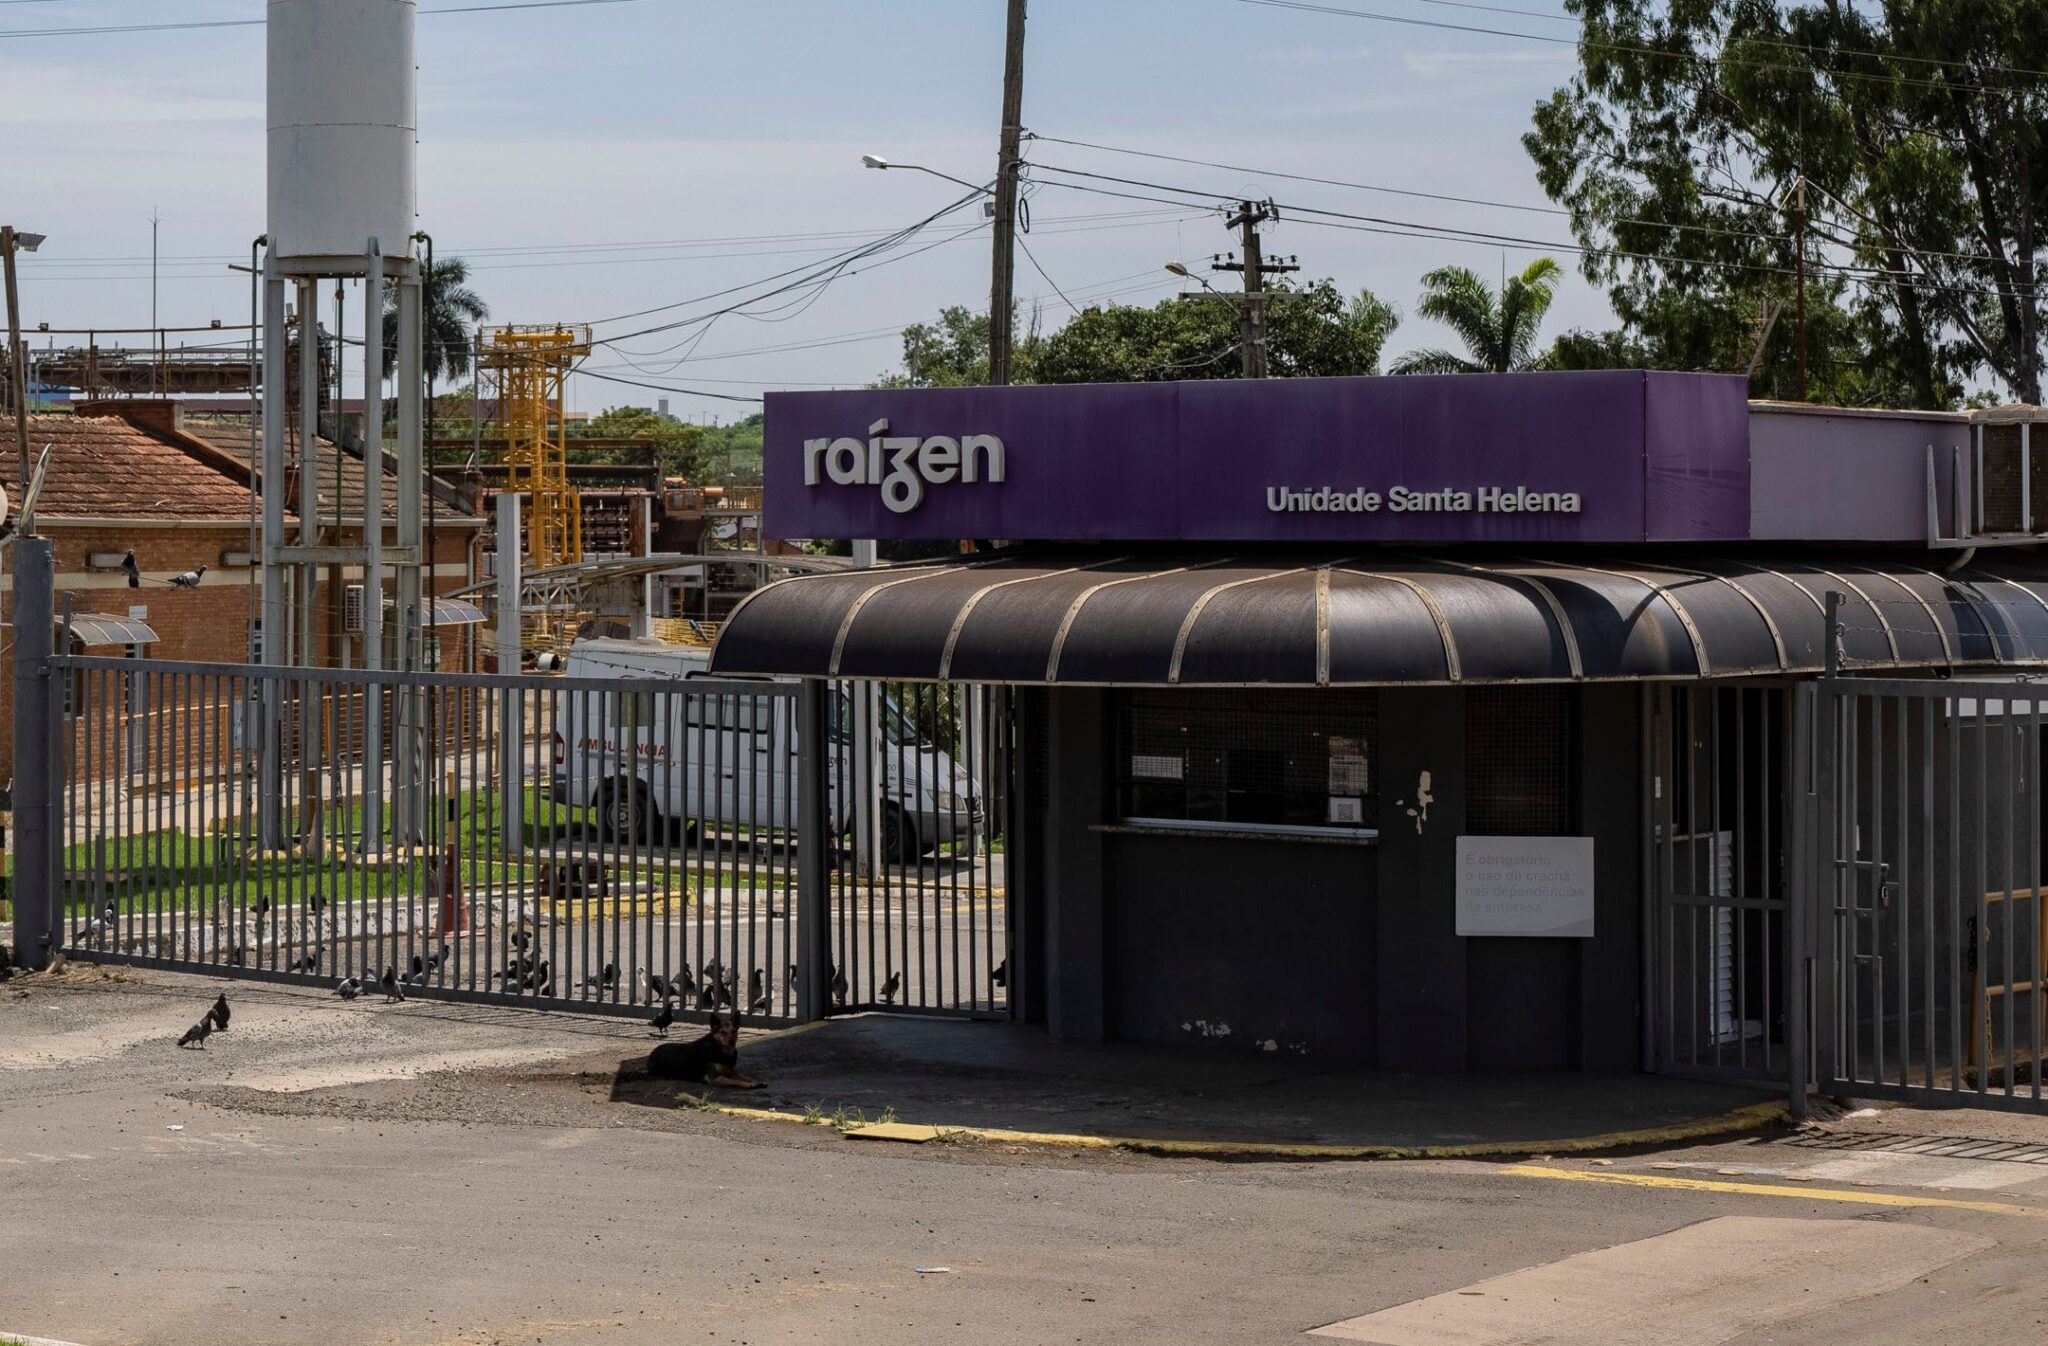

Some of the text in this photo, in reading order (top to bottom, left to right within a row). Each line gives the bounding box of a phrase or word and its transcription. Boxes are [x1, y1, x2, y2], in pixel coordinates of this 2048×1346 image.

[803, 418, 1006, 514] raízen
[1266, 486, 1582, 513] Unidade Santa Helena
[1465, 872, 1473, 881] o
[1478, 872, 1502, 881] uso
[1506, 870, 1522, 881] de
[1465, 887, 1489, 897] nas
